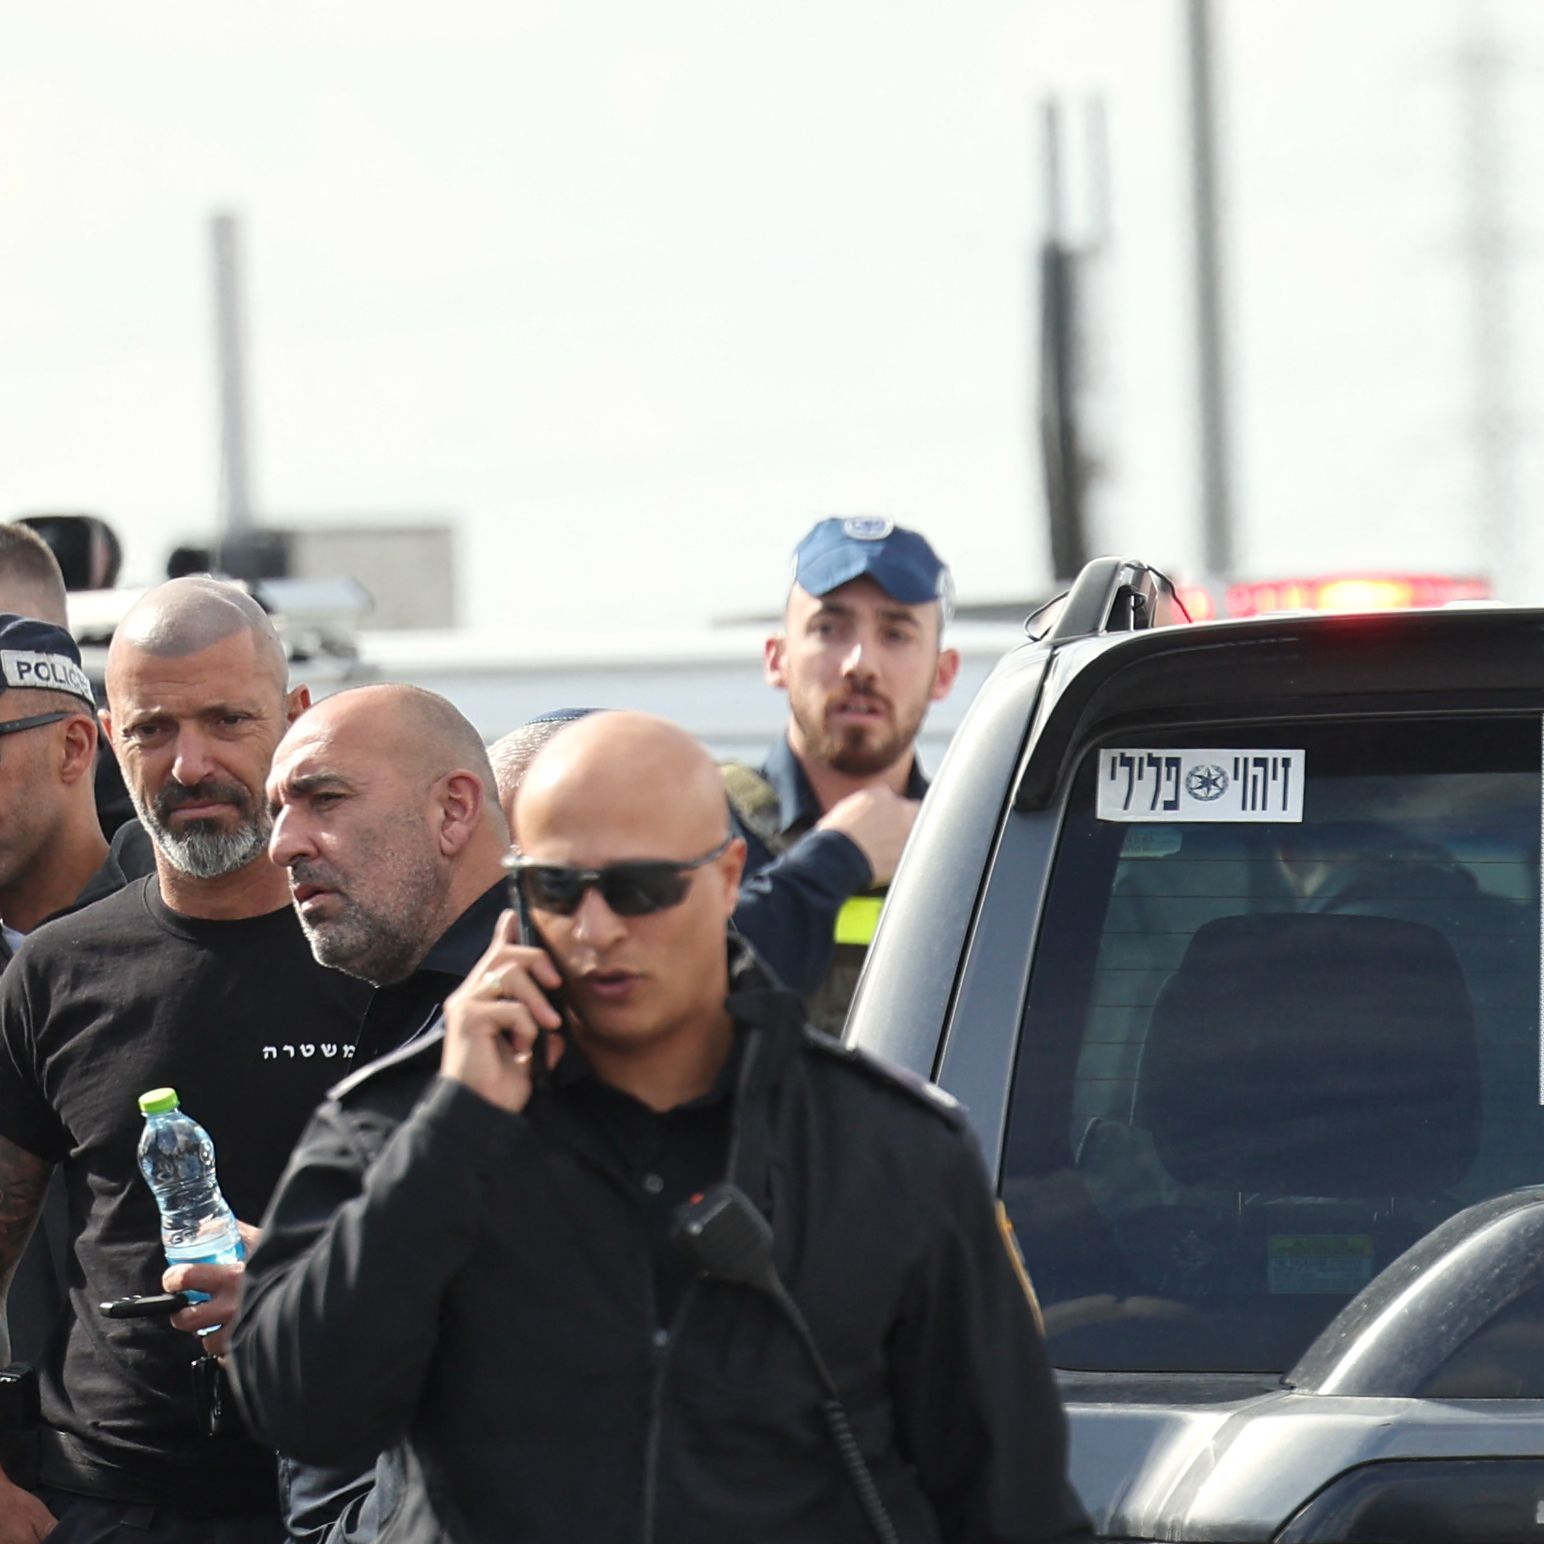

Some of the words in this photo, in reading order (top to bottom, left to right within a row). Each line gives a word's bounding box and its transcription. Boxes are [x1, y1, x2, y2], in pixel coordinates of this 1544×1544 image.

[1110, 752, 1182, 811] פלילי
[1234, 757, 1291, 811] זיהוי
[262, 1043, 356, 1060] משטרה
